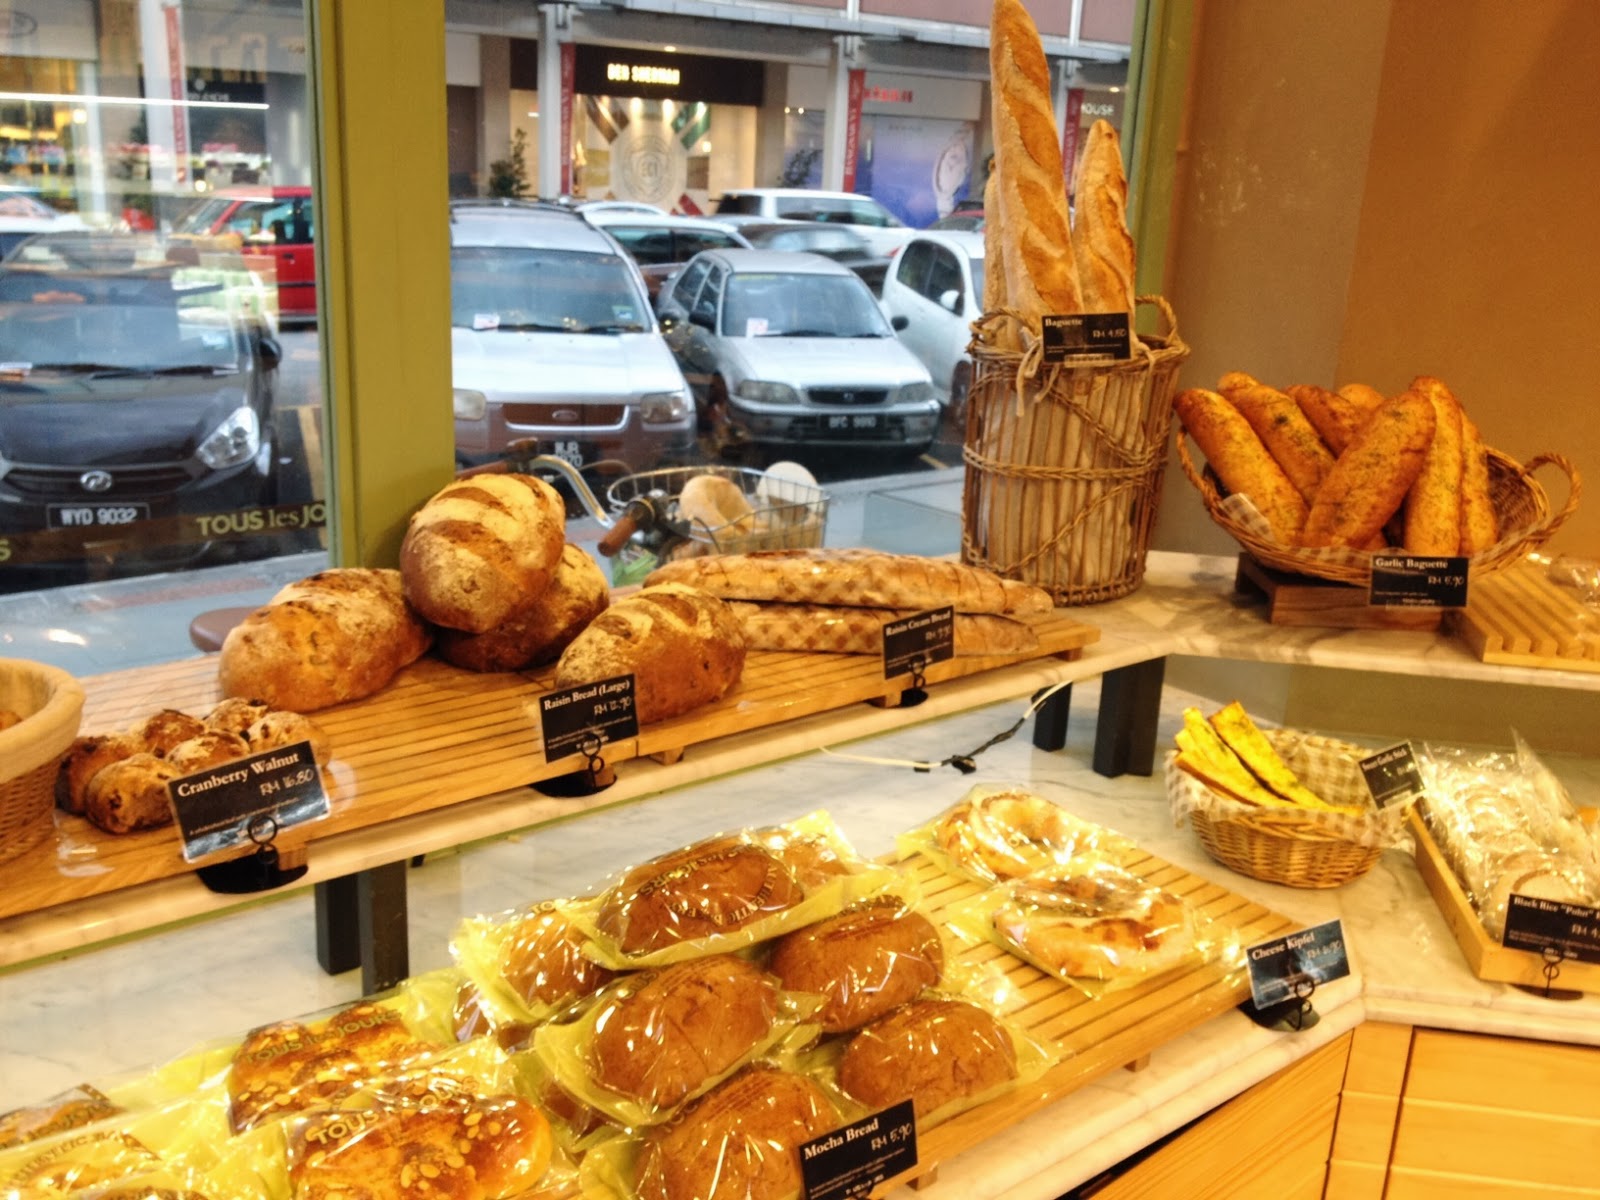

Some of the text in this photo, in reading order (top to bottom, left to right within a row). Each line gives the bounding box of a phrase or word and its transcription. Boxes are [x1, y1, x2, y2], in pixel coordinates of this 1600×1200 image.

[61, 507, 137, 525] WYD 9032
[196, 510, 264, 536] TOUS
[267, 509, 299, 528] les
[1376, 557, 1448, 570] Garlic Baguette
[544, 680, 630, 710] Raisin Bread (Large)
[177, 752, 299, 797] Cranberry Walnut
[259, 779, 281, 796] RM
[1514, 896, 1537, 909] Black
[1539, 901, 1558, 912] Rice
[1252, 932, 1315, 960] Cheese Kipfel
[314, 1111, 380, 1145] TOUS
[804, 1118, 879, 1160] Mocha Bread
